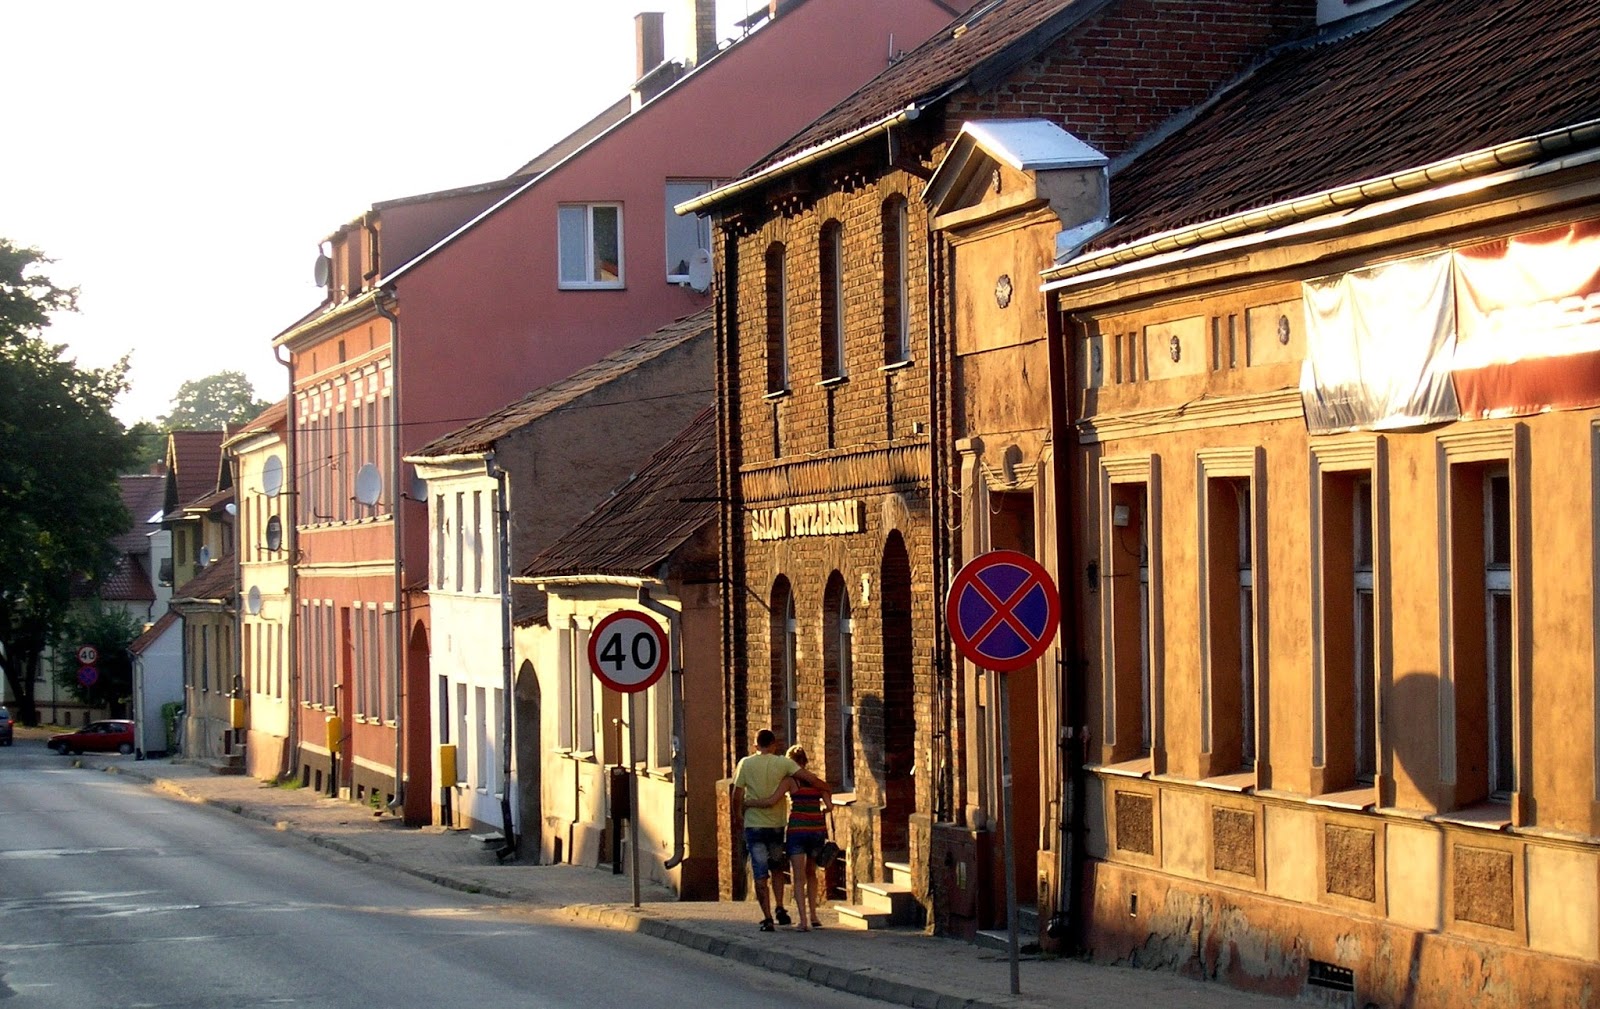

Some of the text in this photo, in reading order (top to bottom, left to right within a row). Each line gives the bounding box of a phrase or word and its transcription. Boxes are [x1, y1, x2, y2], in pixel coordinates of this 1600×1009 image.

[752, 508, 786, 541] SALON
[81, 650, 95, 660] 40
[600, 632, 657, 671] 40
